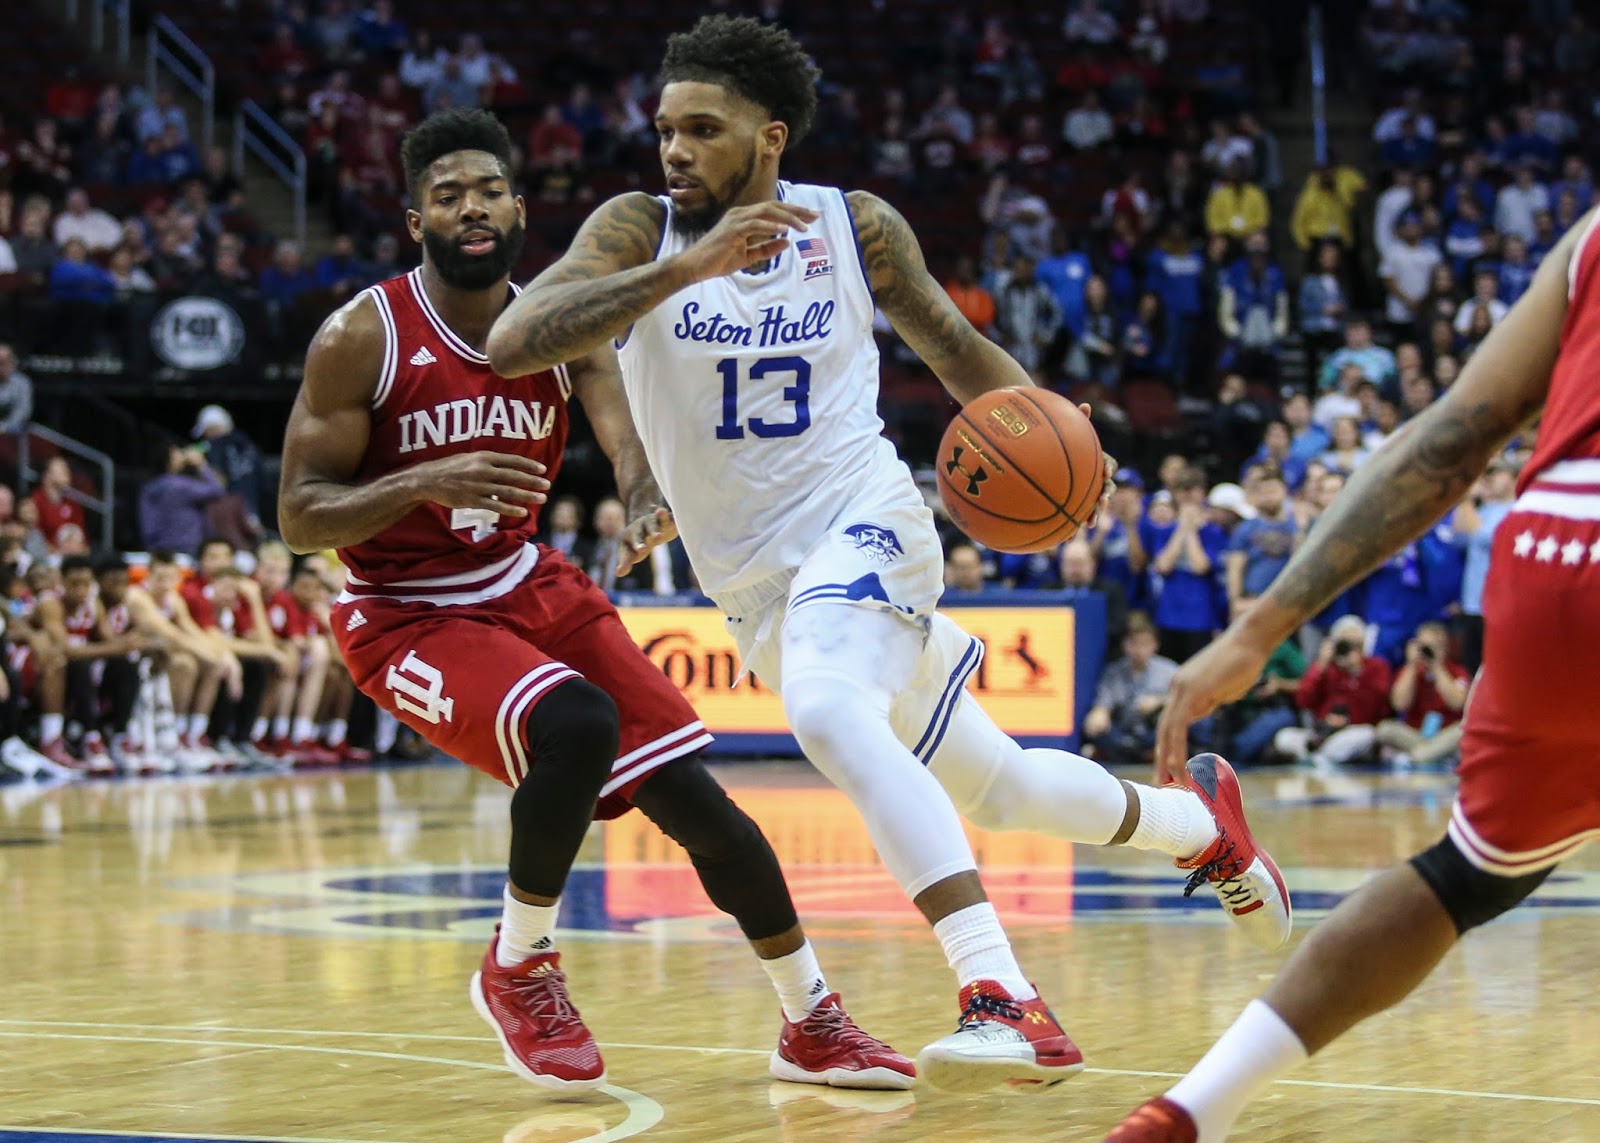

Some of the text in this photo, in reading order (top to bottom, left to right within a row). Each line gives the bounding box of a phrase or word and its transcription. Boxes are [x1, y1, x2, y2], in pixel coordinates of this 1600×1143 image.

[805, 265, 833, 276] EAST
[807, 259, 828, 269] BIG
[675, 300, 835, 347] Seton Hall
[716, 356, 811, 439] 13
[398, 395, 556, 453] INDIANA
